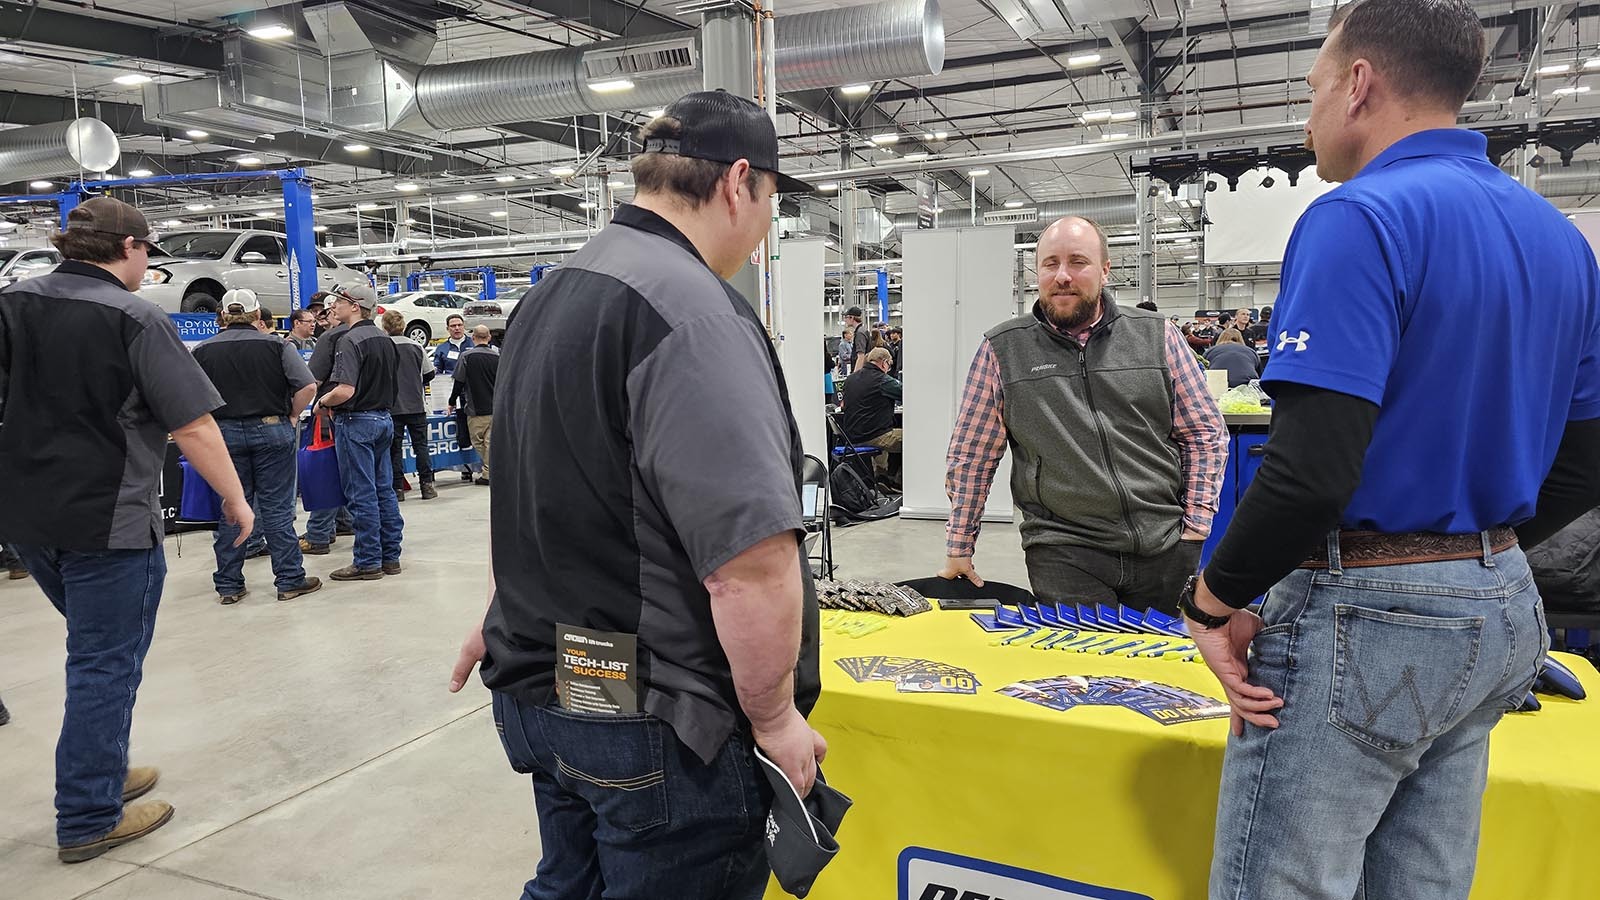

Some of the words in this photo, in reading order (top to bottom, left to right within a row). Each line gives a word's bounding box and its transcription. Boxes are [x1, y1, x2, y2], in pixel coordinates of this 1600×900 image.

[566, 648, 587, 657] YOUR
[562, 653, 630, 672] TECH-LIST
[573, 665, 627, 680] SUCCESS
